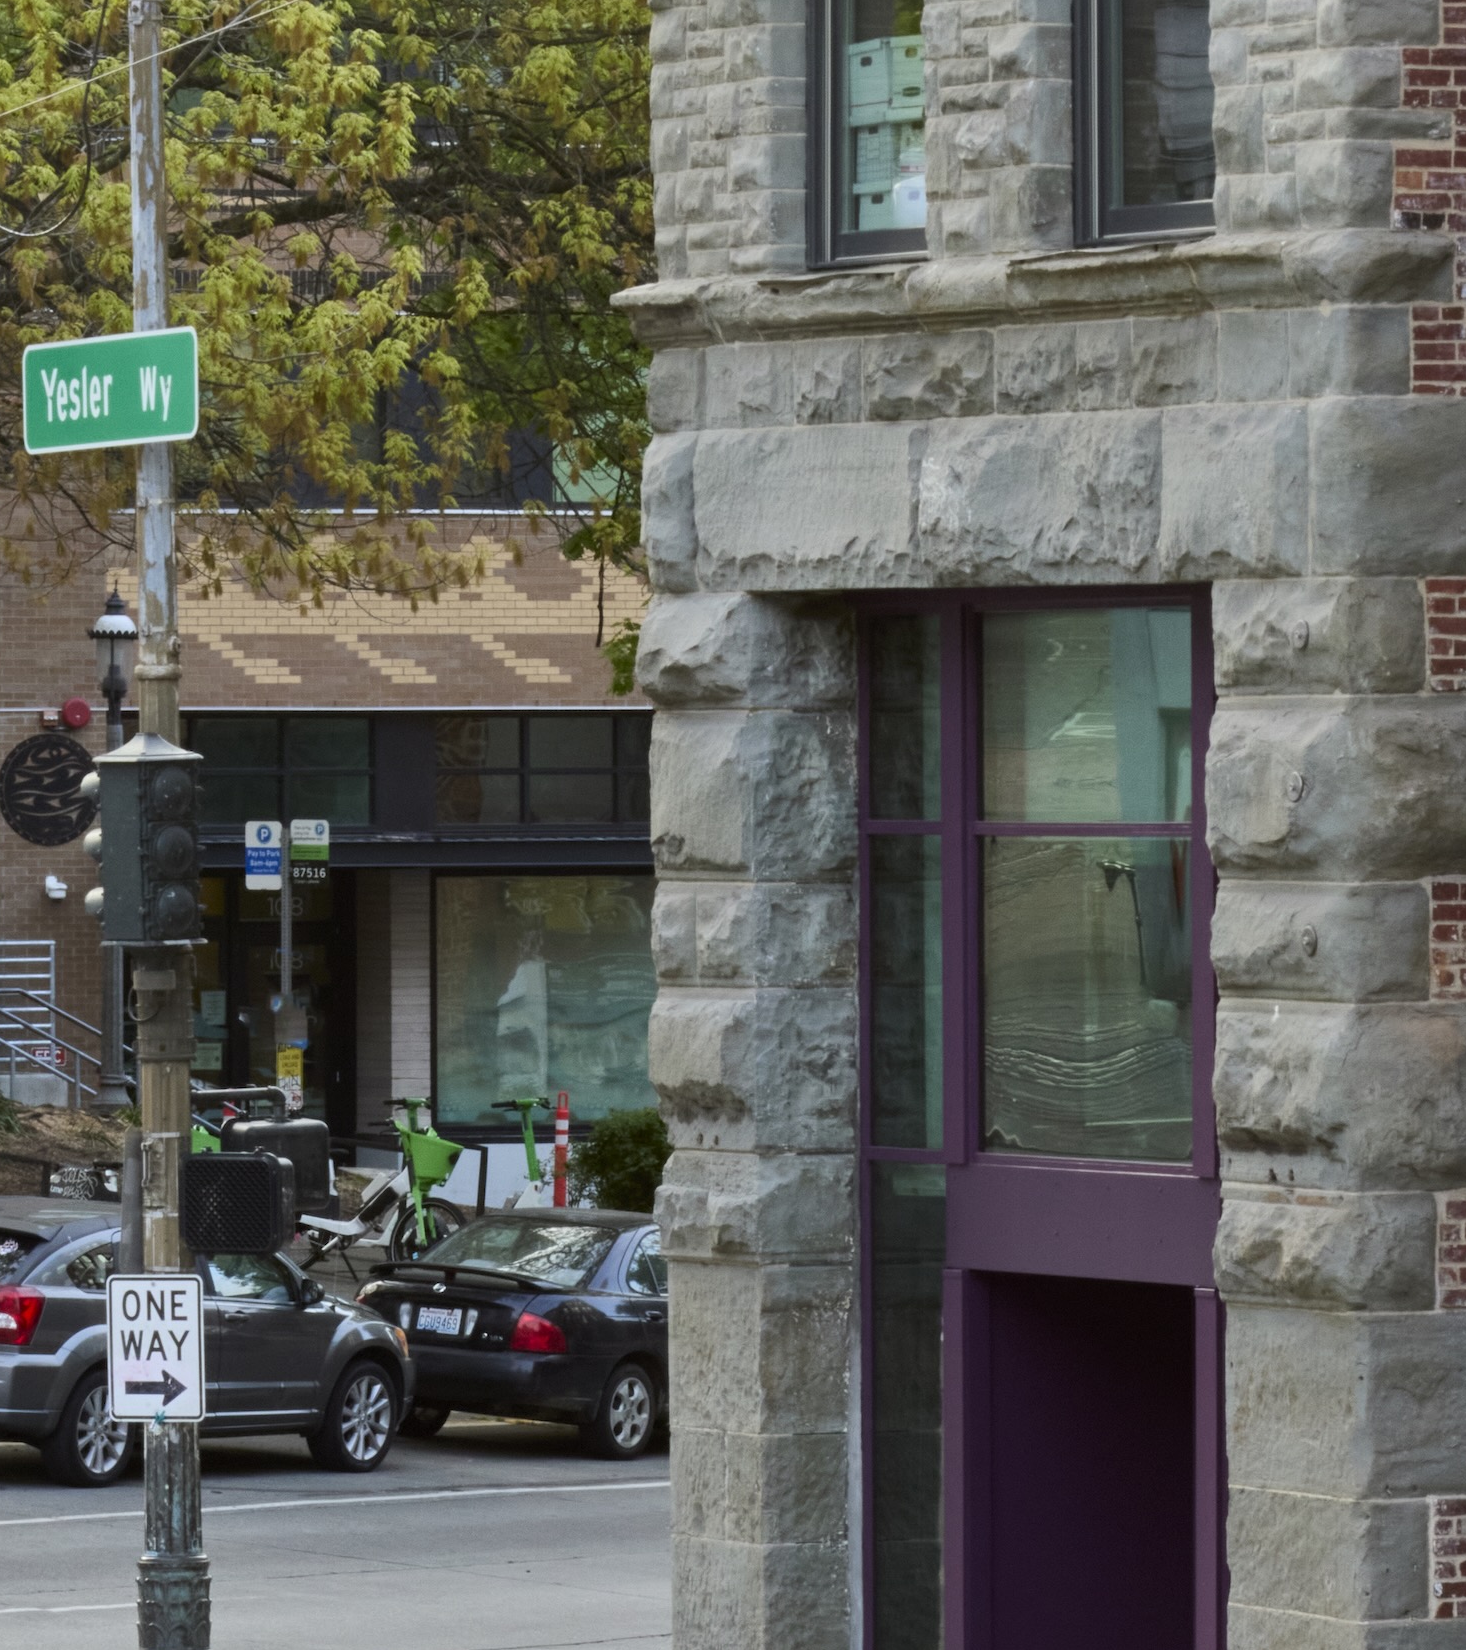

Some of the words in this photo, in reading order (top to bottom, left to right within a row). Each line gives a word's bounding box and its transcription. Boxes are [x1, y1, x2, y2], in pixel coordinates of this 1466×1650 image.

[40, 365, 113, 423] Yesler
[139, 365, 172, 422] Wy
[293, 867, 326, 878] 87516
[122, 1290, 188, 1322] ONE
[120, 1330, 190, 1361] WAY
